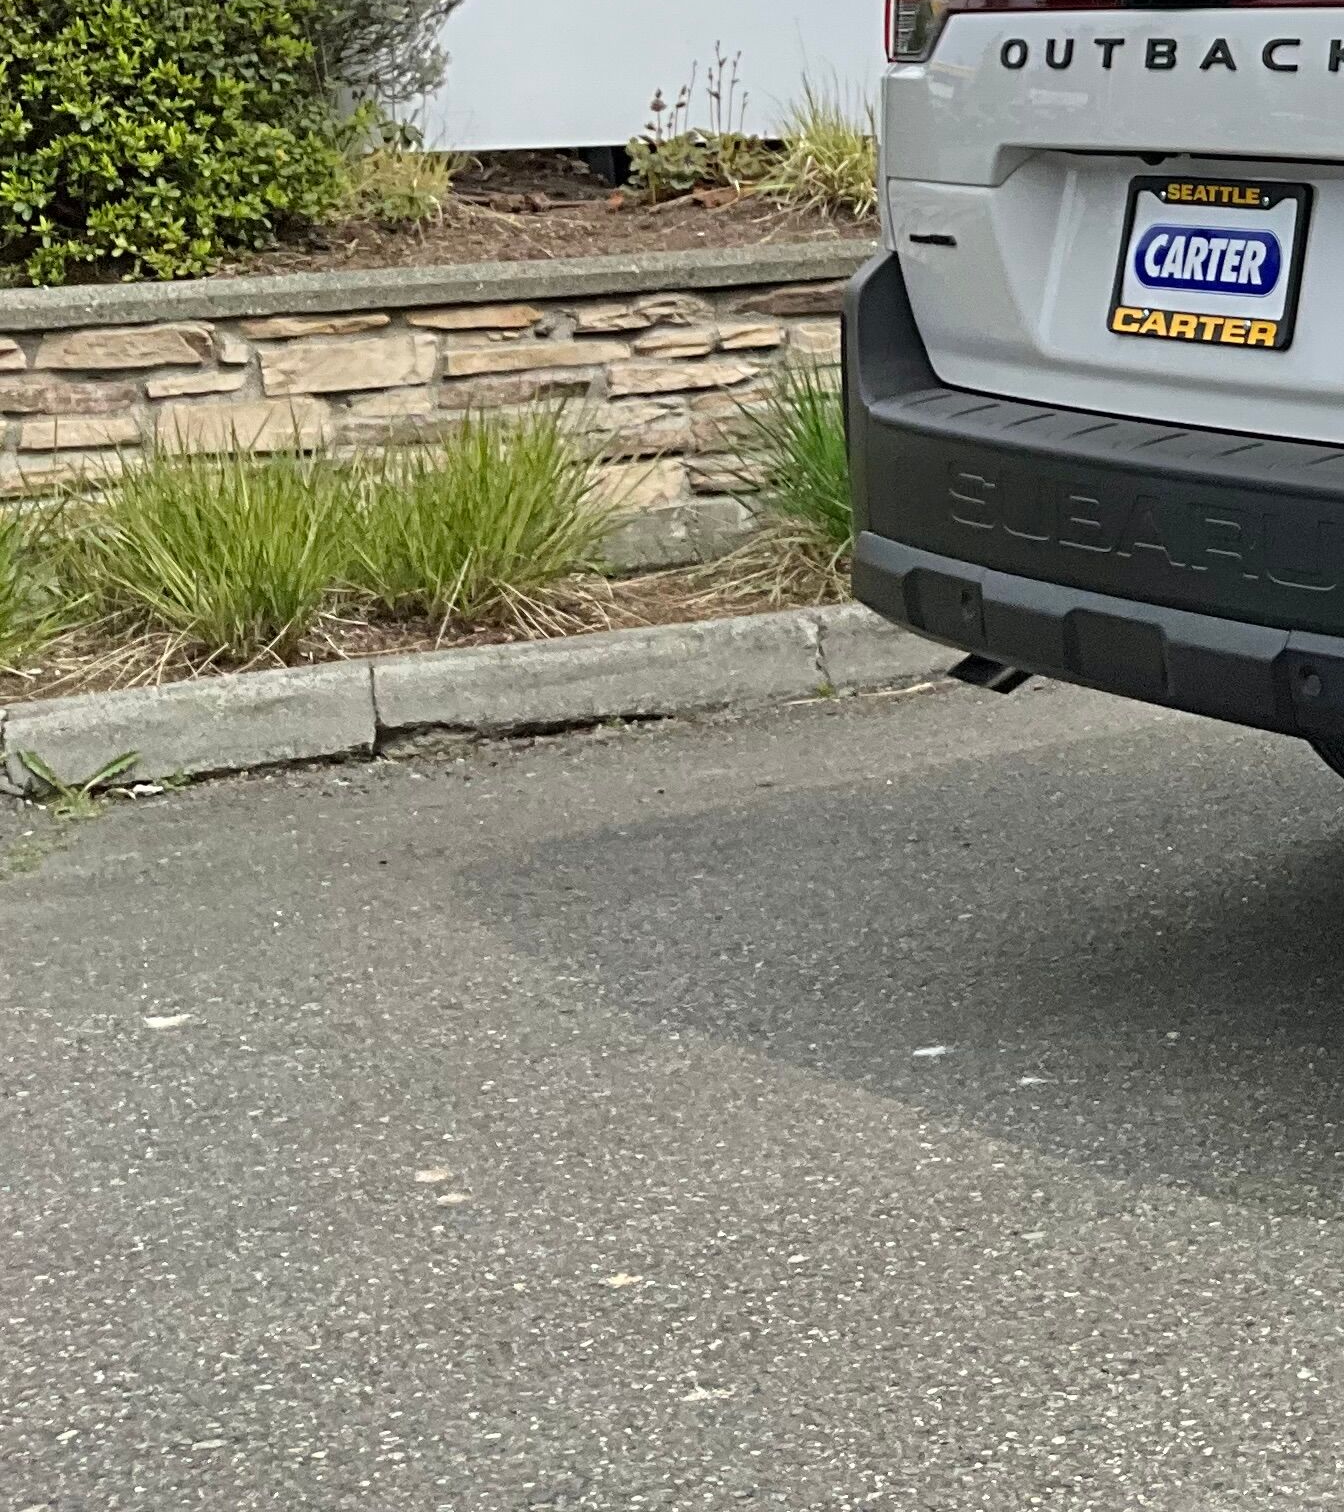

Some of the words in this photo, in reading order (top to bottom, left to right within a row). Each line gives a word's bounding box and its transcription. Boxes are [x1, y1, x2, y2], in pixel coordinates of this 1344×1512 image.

[1167, 184, 1260, 204] SEATTLE
[1144, 234, 1267, 285] CARTER
[1112, 306, 1277, 347] CARTER
[948, 460, 1337, 592] SUBARU
